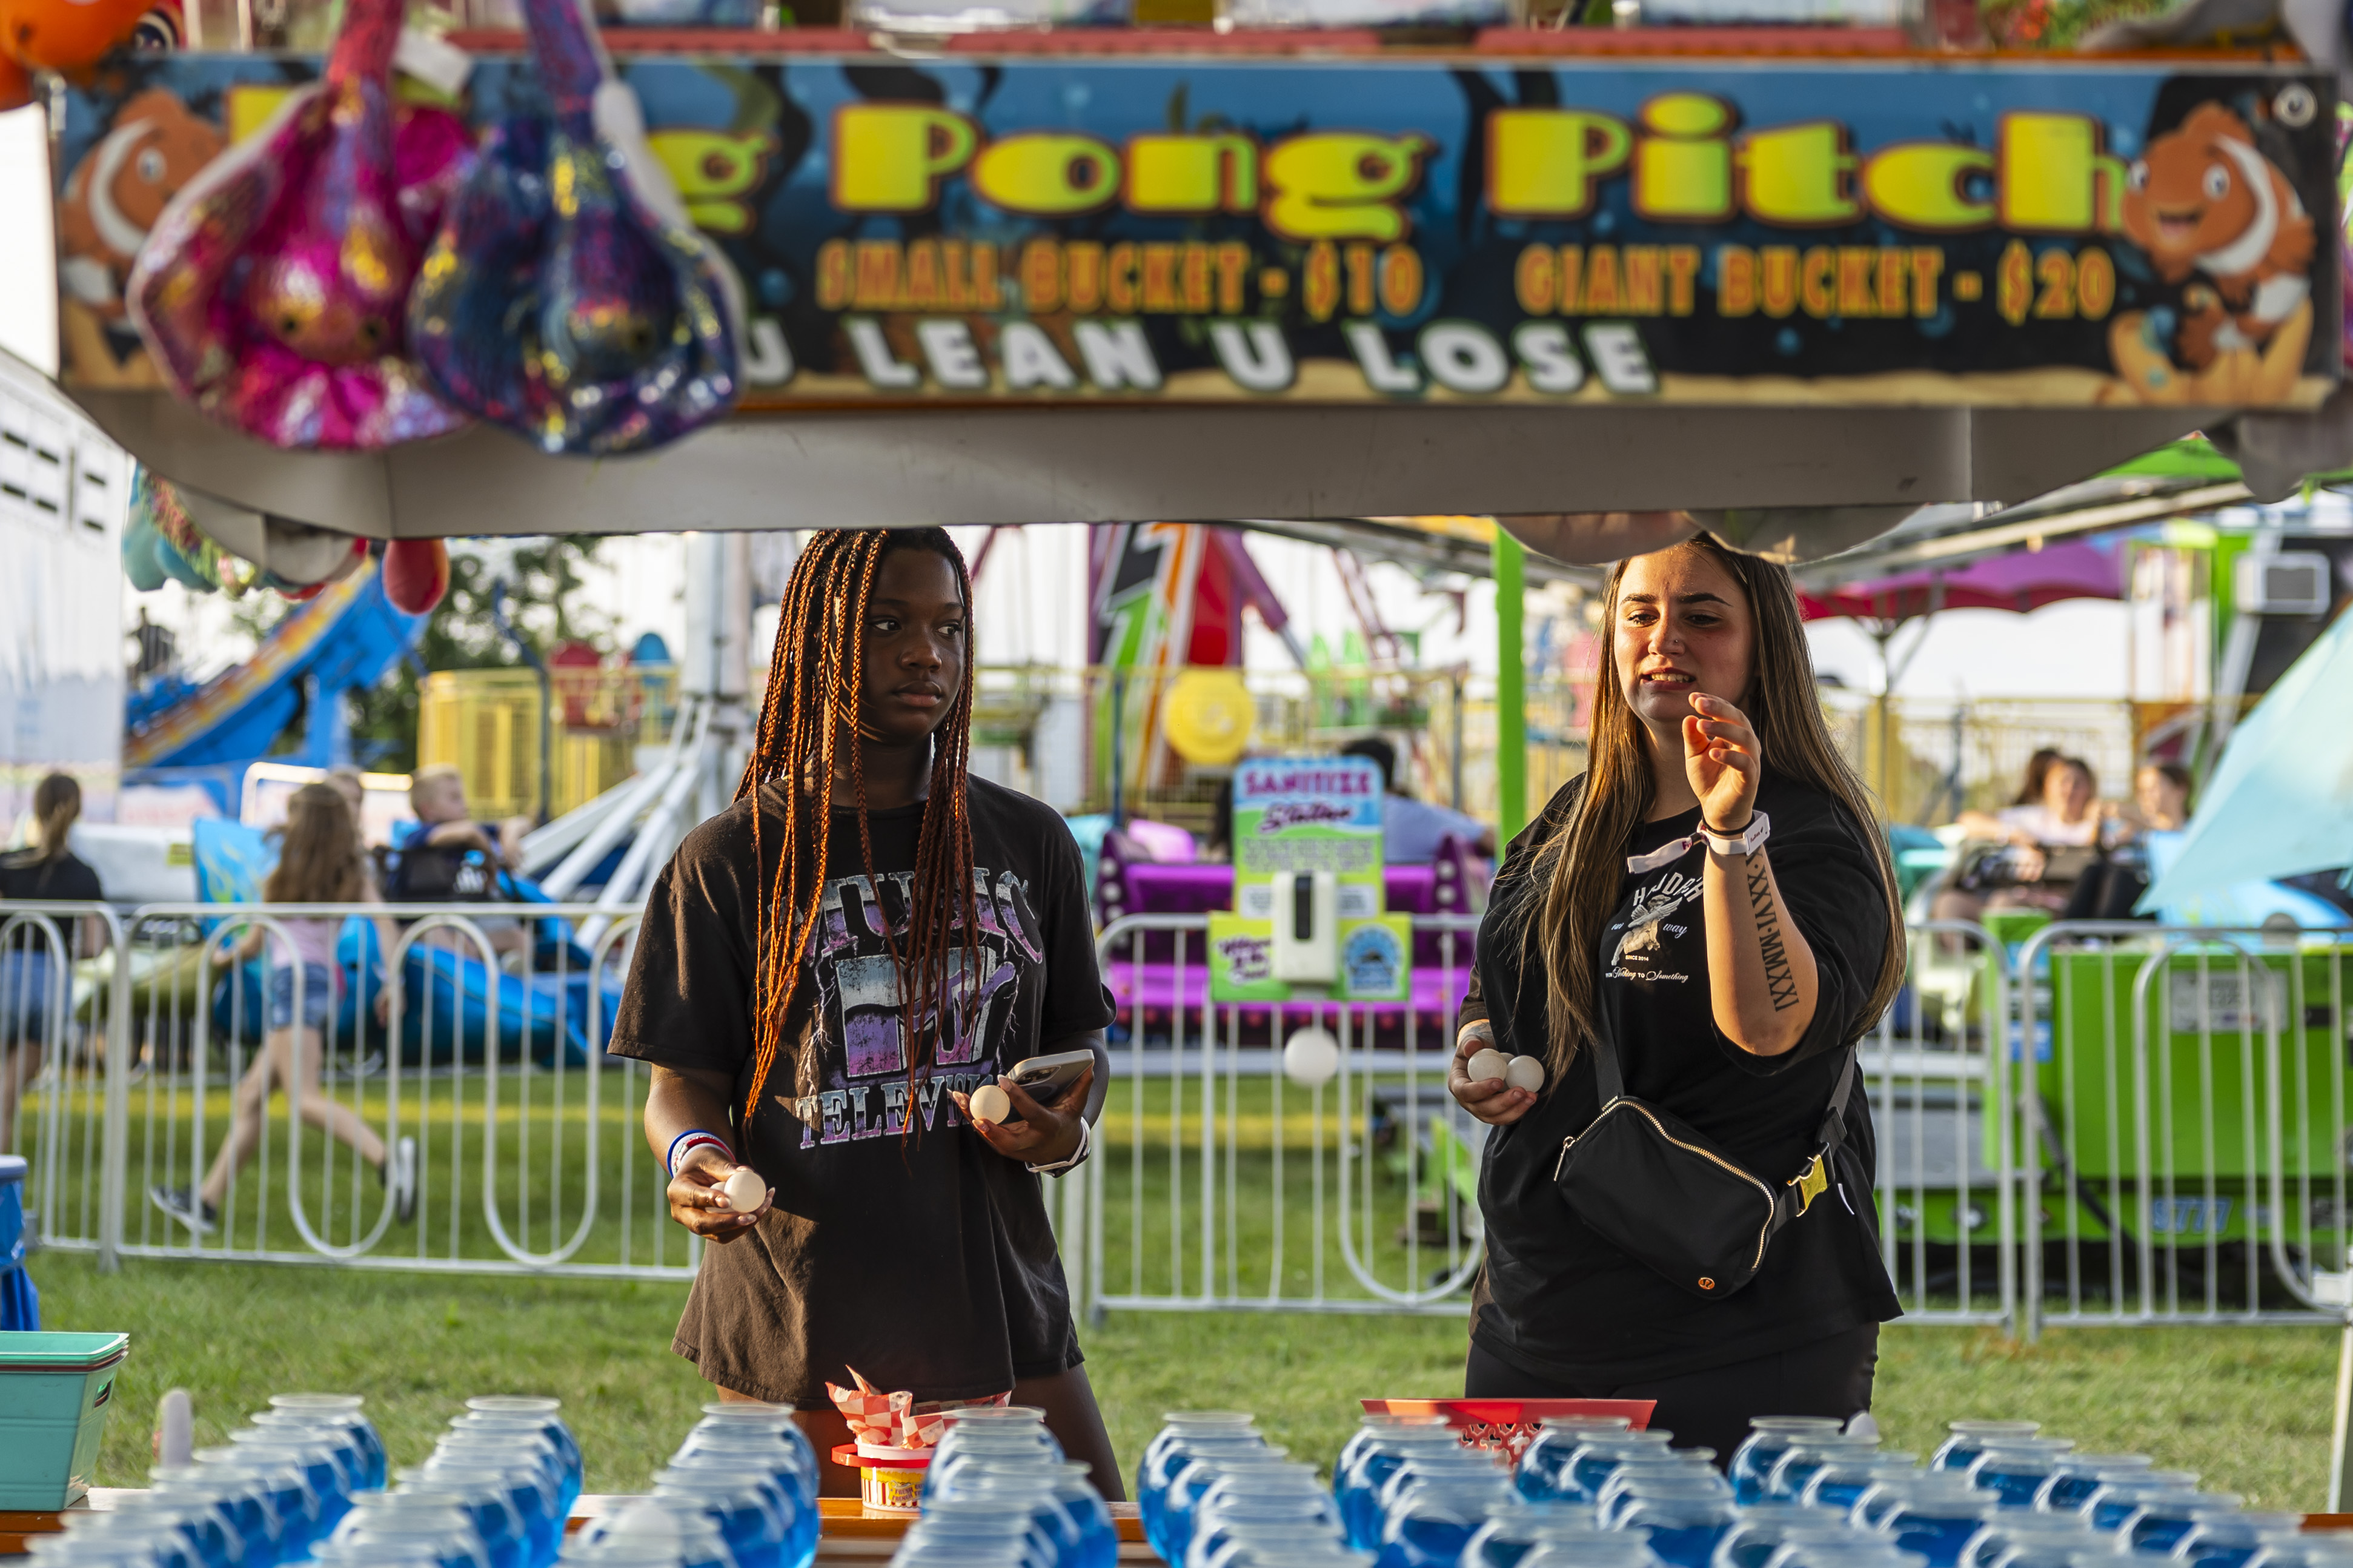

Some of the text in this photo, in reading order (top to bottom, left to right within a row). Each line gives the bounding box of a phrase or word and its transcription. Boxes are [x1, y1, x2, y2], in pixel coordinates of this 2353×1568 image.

[831, 100, 1441, 240] Pong
[1485, 89, 2130, 231] Pitch
[816, 238, 1001, 311] SMALL
[1018, 238, 1252, 314] BUCKET
[1302, 237, 1424, 322] $10
[1515, 241, 1702, 317] GIANT
[1716, 244, 1943, 319] BUCKET
[1996, 238, 2116, 327] $20
[843, 316, 1163, 391] LEAN
[1206, 317, 1297, 393] U
[1341, 317, 1661, 395] LOSE
[1662, 923, 1688, 939] way
[1645, 970, 1689, 984] Something
